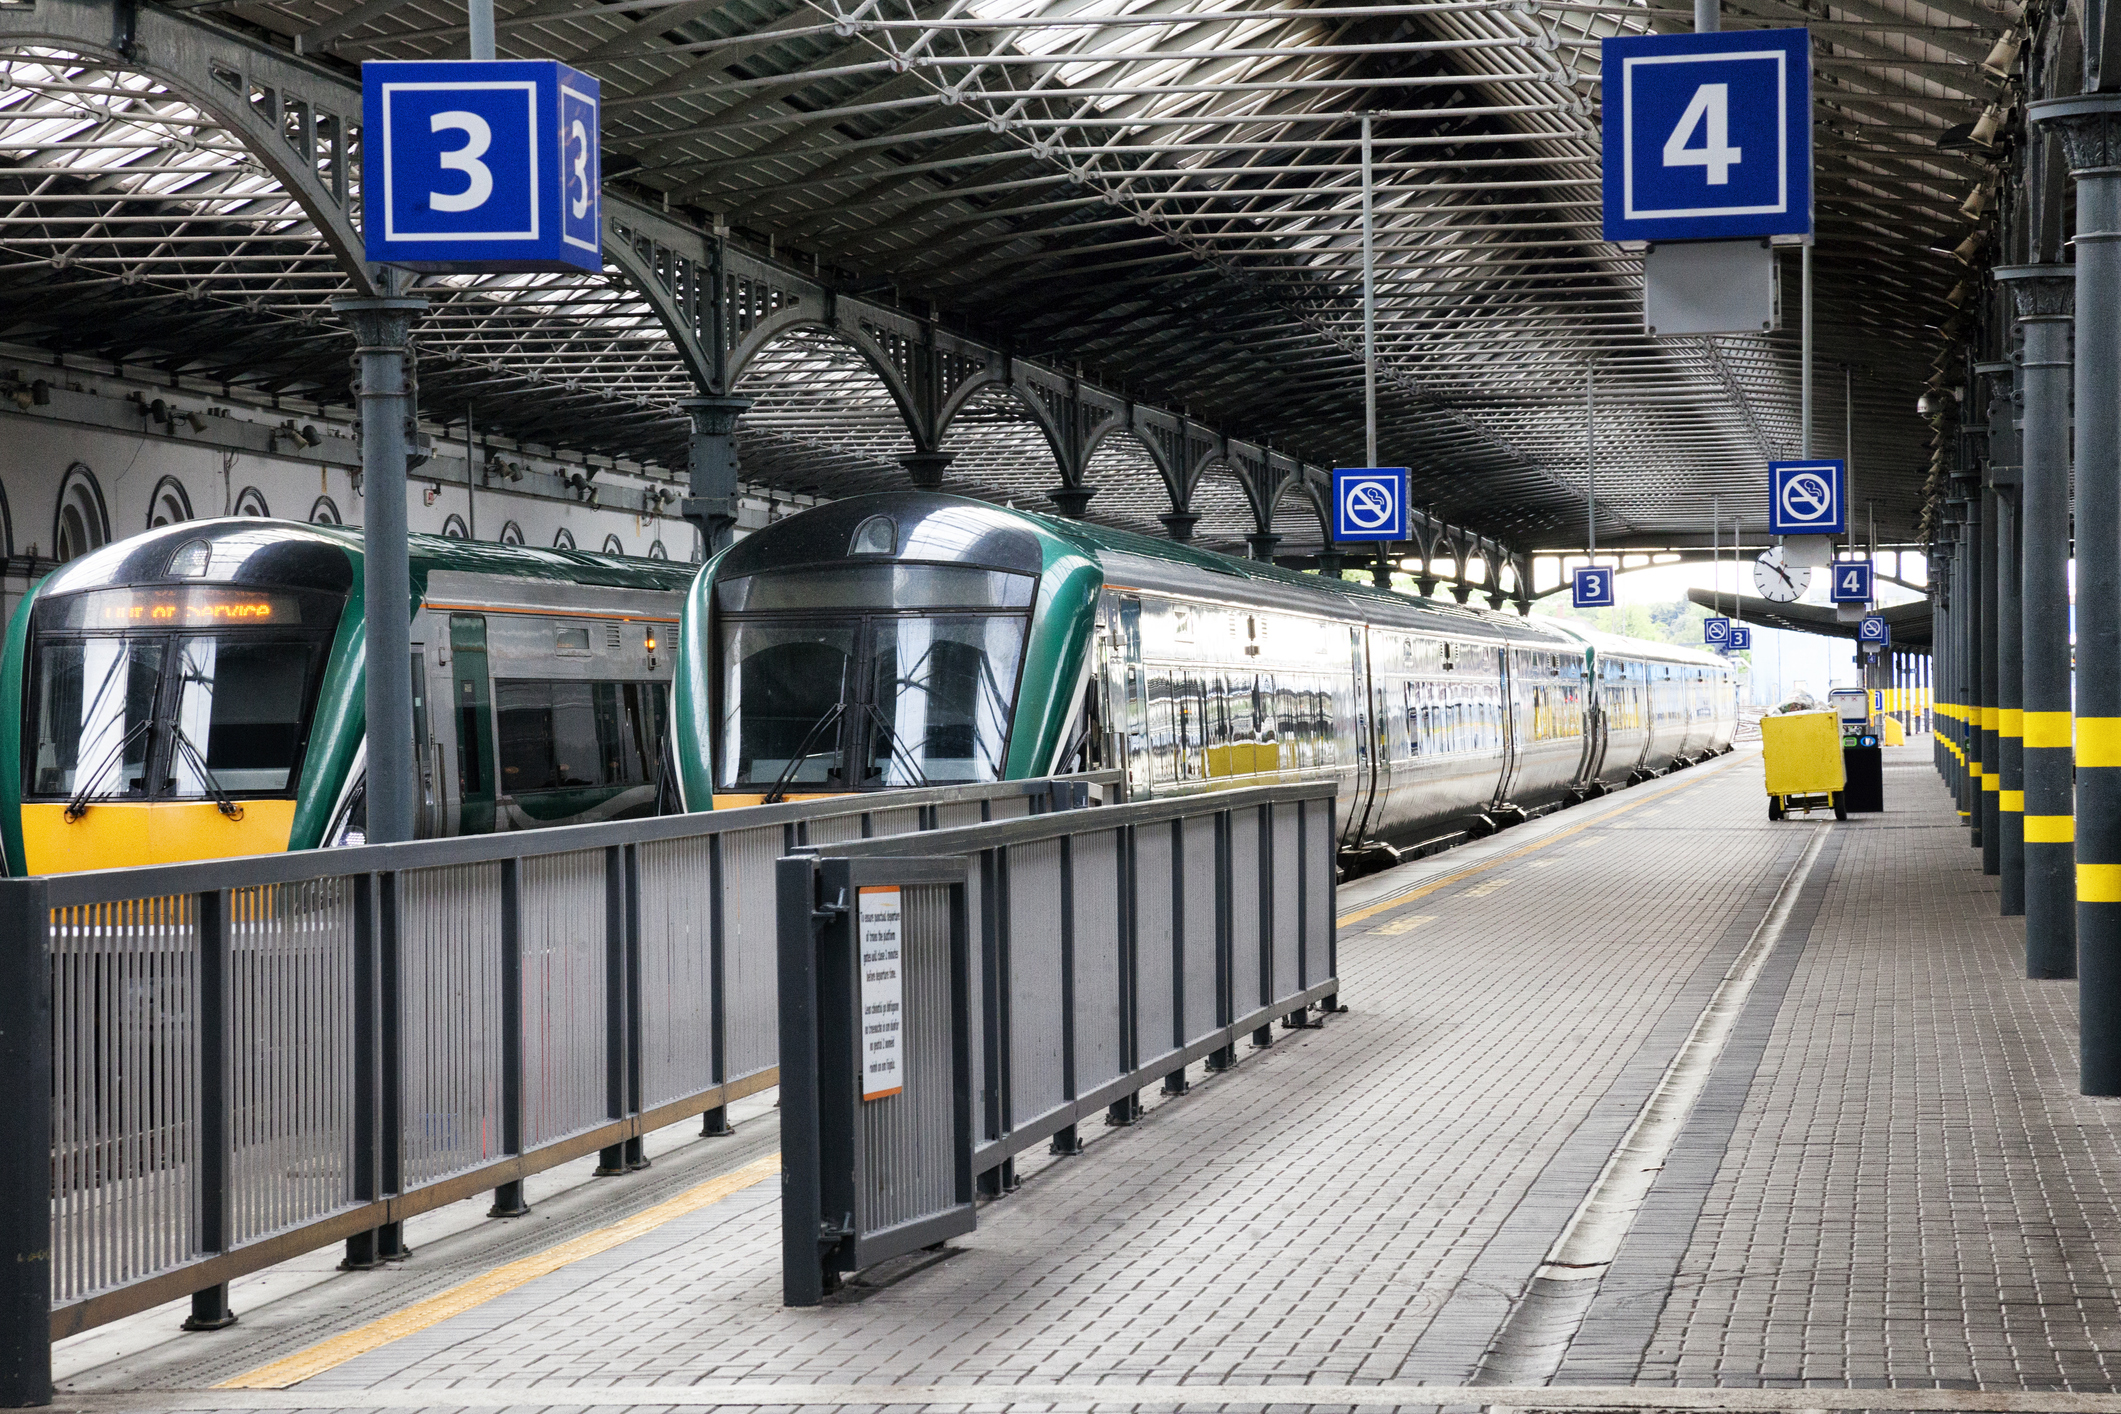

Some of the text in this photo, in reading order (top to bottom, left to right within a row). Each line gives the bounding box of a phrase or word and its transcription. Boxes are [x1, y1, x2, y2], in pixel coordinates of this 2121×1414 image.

[1663, 83, 1741, 185] 4
[430, 111, 493, 212] 3
[572, 120, 588, 219] 3
[1586, 575, 1601, 597] 3
[1842, 570, 1860, 592] 4
[1734, 632, 1743, 645] 3
[865, 914, 874, 922] ensure
[883, 929, 895, 944] platform
